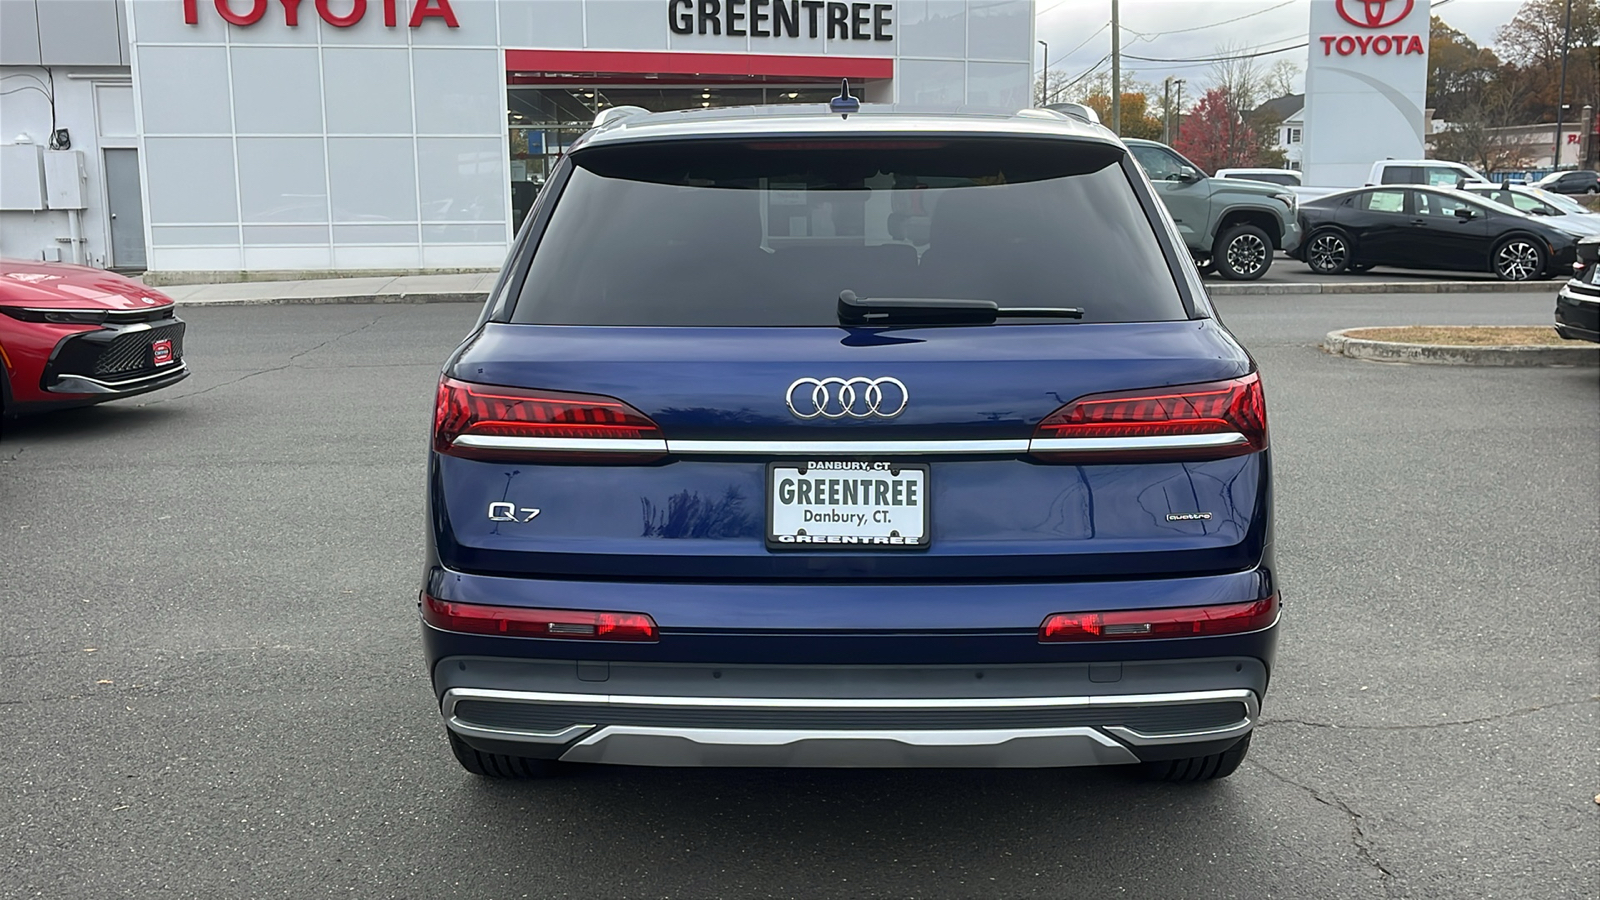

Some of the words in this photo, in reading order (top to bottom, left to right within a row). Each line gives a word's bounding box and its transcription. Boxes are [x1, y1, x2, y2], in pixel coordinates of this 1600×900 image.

[668, 0, 893, 41] GREENTREE
[1319, 35, 1424, 56] TOYOTA
[807, 461, 870, 472] DANBURY,
[873, 462, 891, 471] CT
[778, 478, 918, 506] GREENTREE
[488, 501, 541, 523] Q7
[803, 508, 868, 527] Danbury,
[872, 510, 892, 524] CT.
[1168, 513, 1211, 521] quattro
[778, 535, 920, 545] GREENTREE
